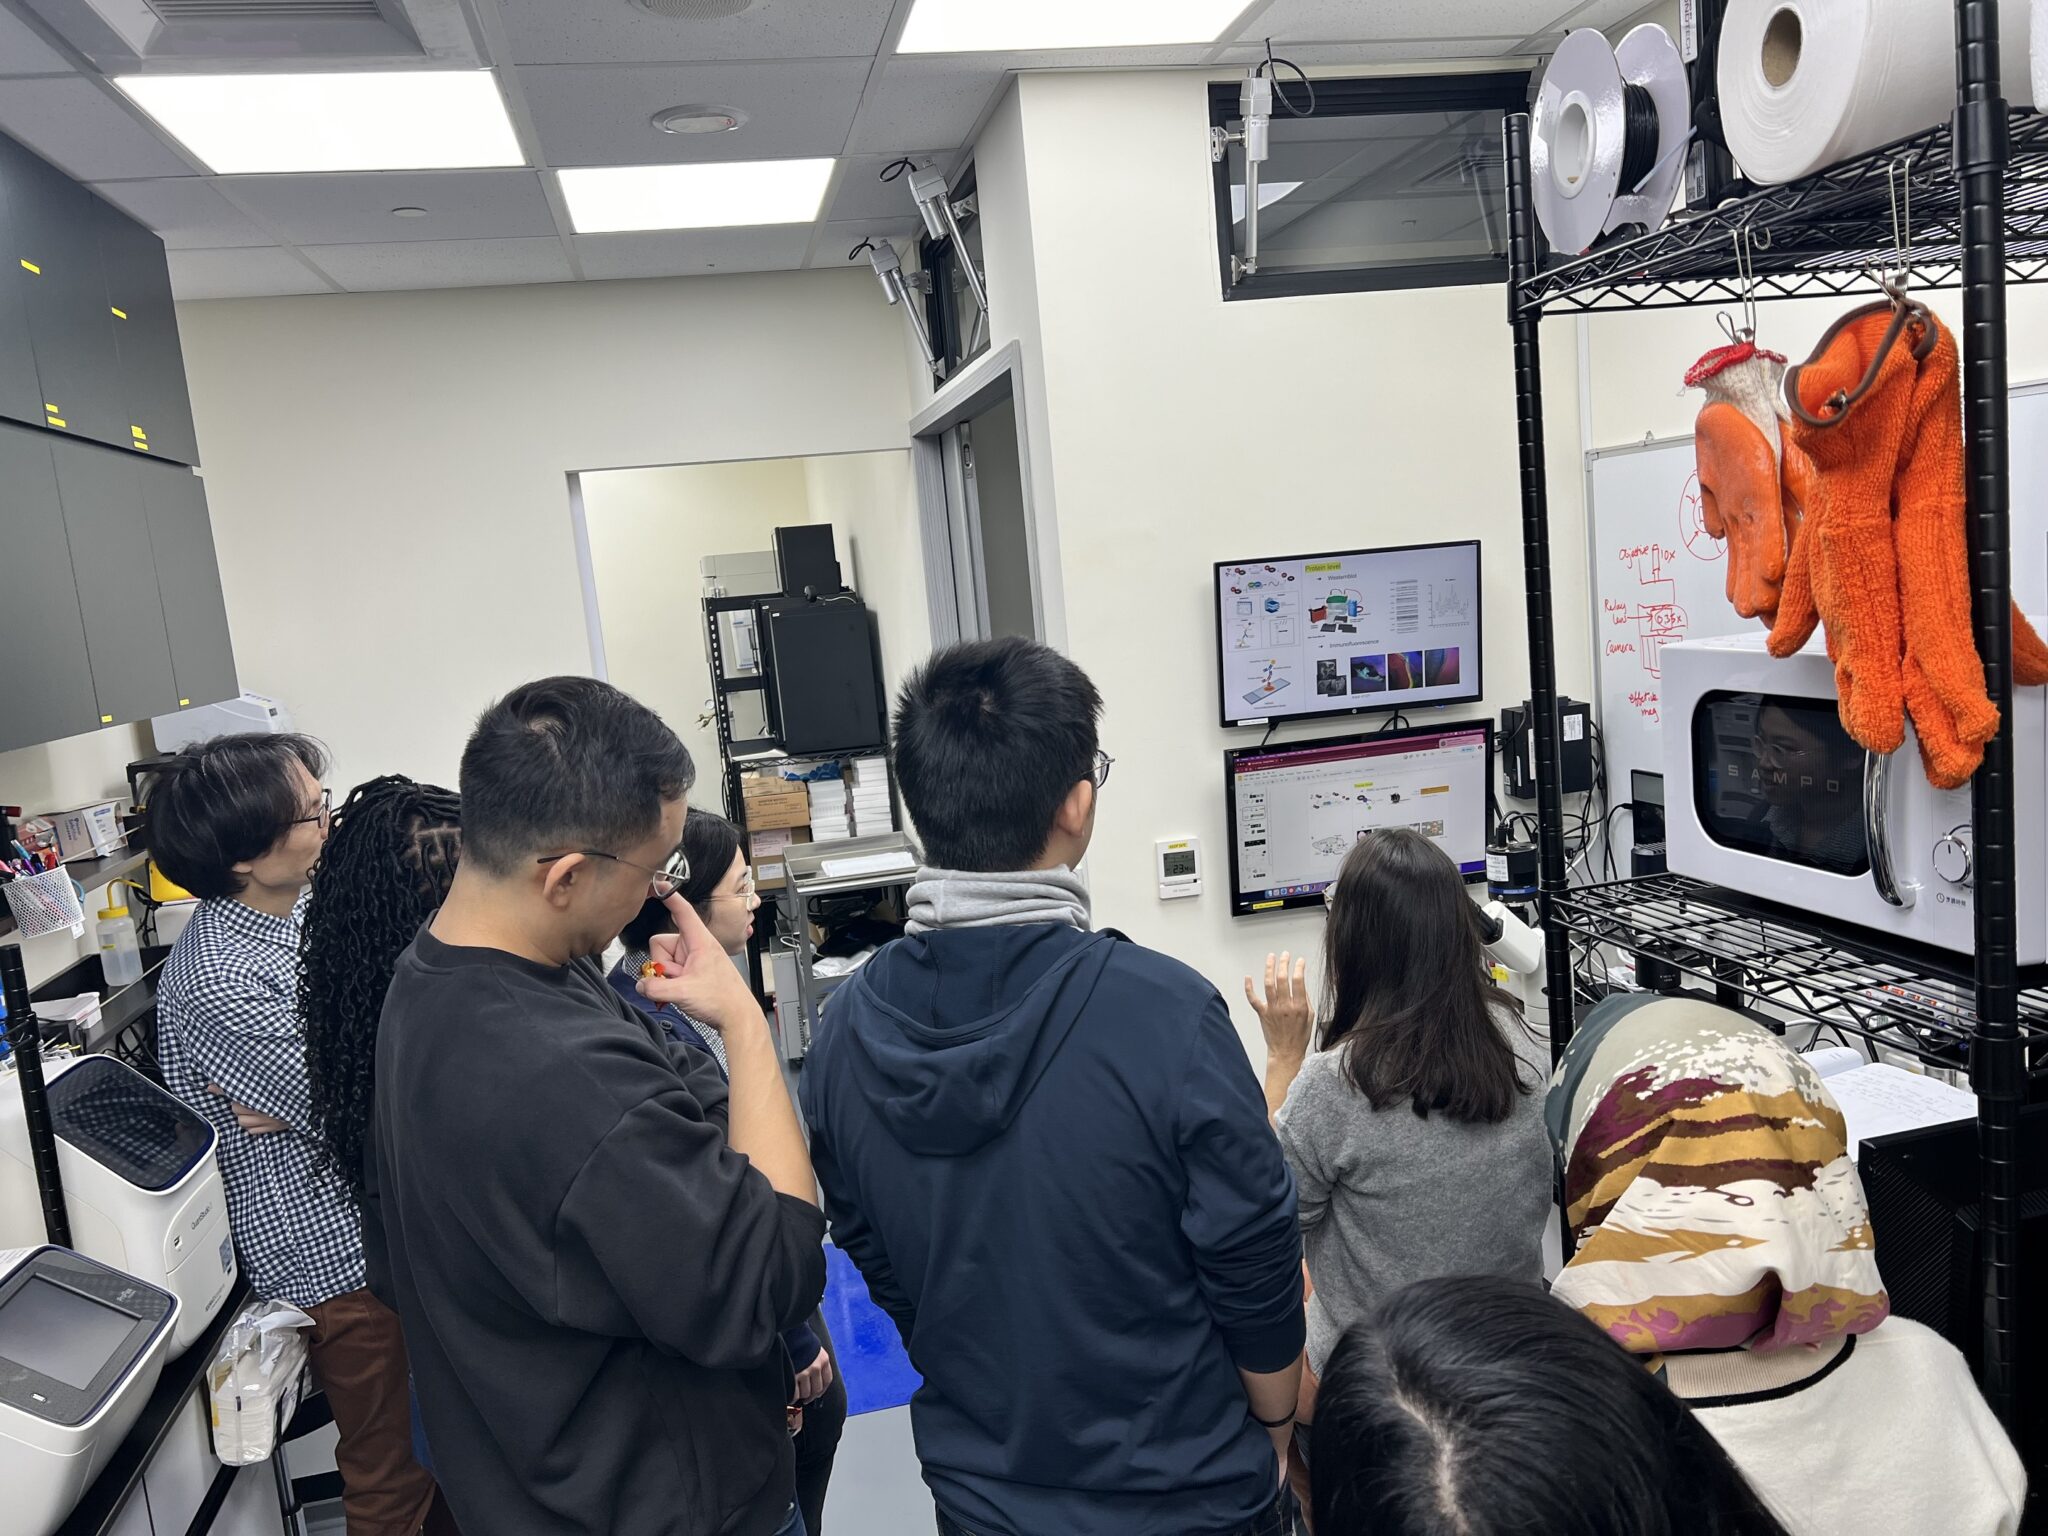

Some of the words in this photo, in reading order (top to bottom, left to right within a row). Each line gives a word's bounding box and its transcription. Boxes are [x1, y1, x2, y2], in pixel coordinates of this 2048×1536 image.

[1305, 564, 1325, 573] Protein
[1327, 562, 1341, 570] level
[1728, 764, 1839, 793] SAMPO
